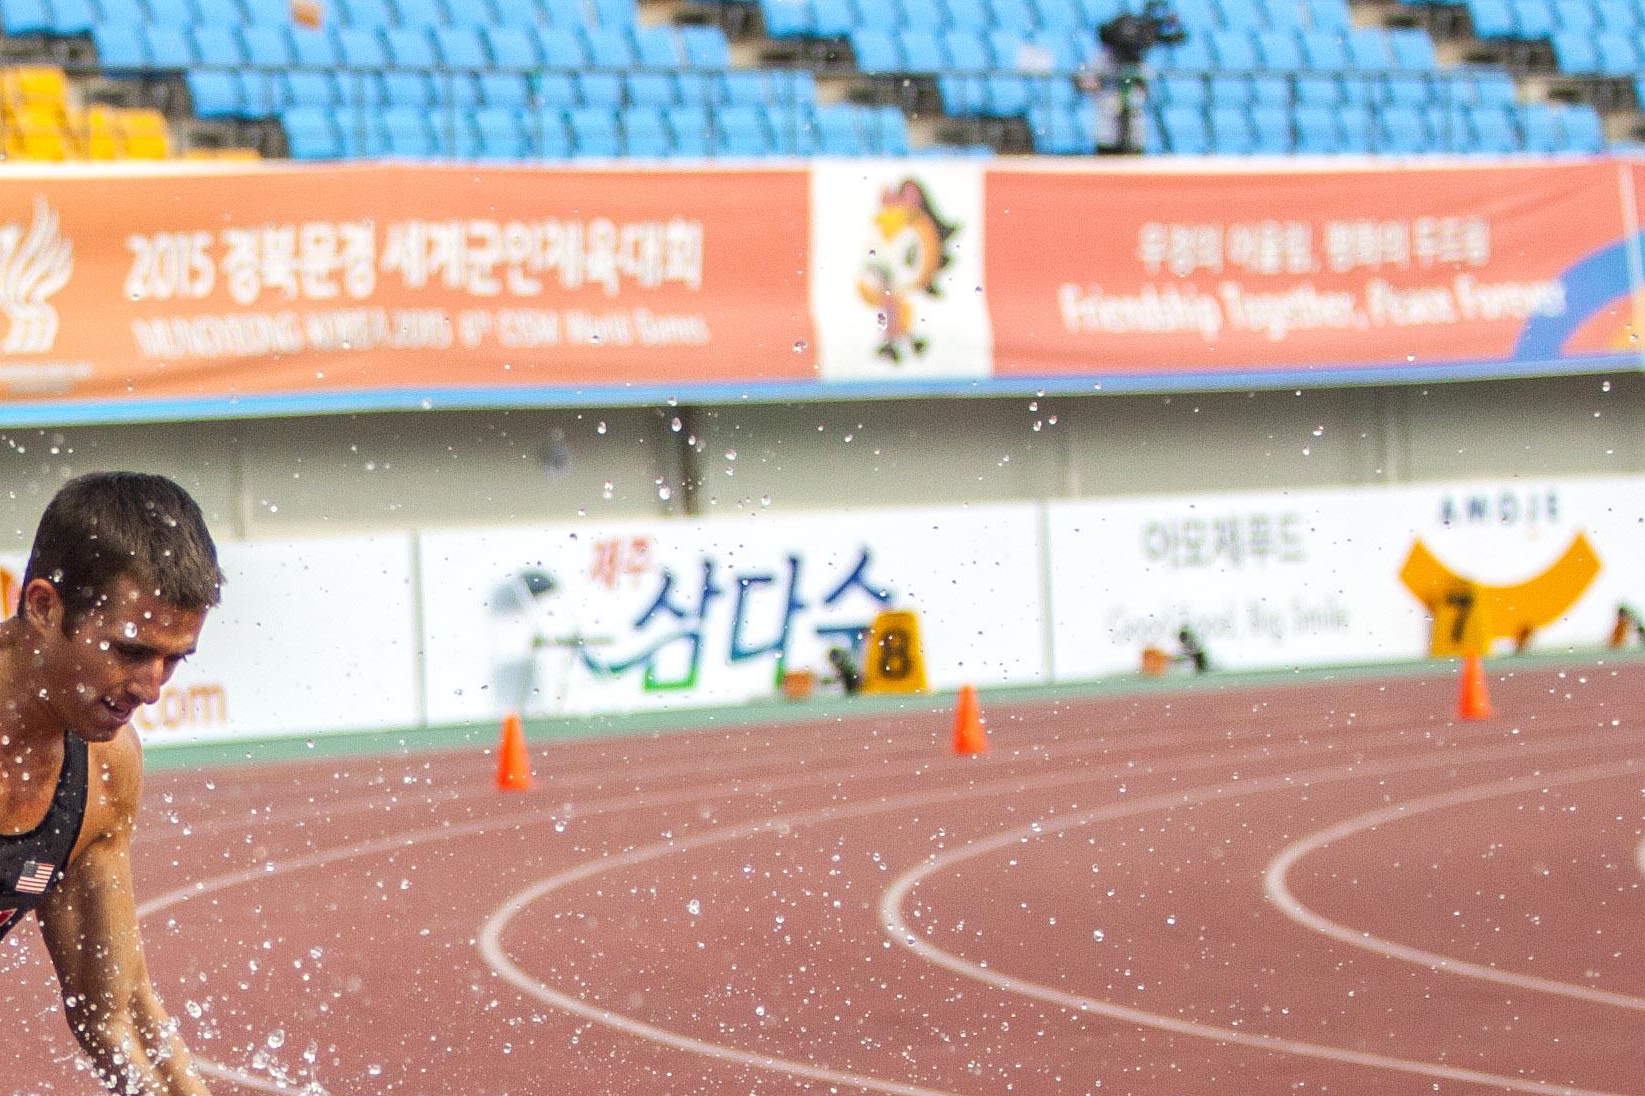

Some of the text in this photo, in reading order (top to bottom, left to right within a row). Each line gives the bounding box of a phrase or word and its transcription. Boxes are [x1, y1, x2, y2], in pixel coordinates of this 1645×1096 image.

[124, 214, 702, 304] 2015 경북문경 세계군인체육대회
[1058, 282, 1220, 340] Friendship
[581, 545, 893, 692] 삼다수
[1445, 592, 1475, 643] 7
[878, 626, 912, 682] 8
